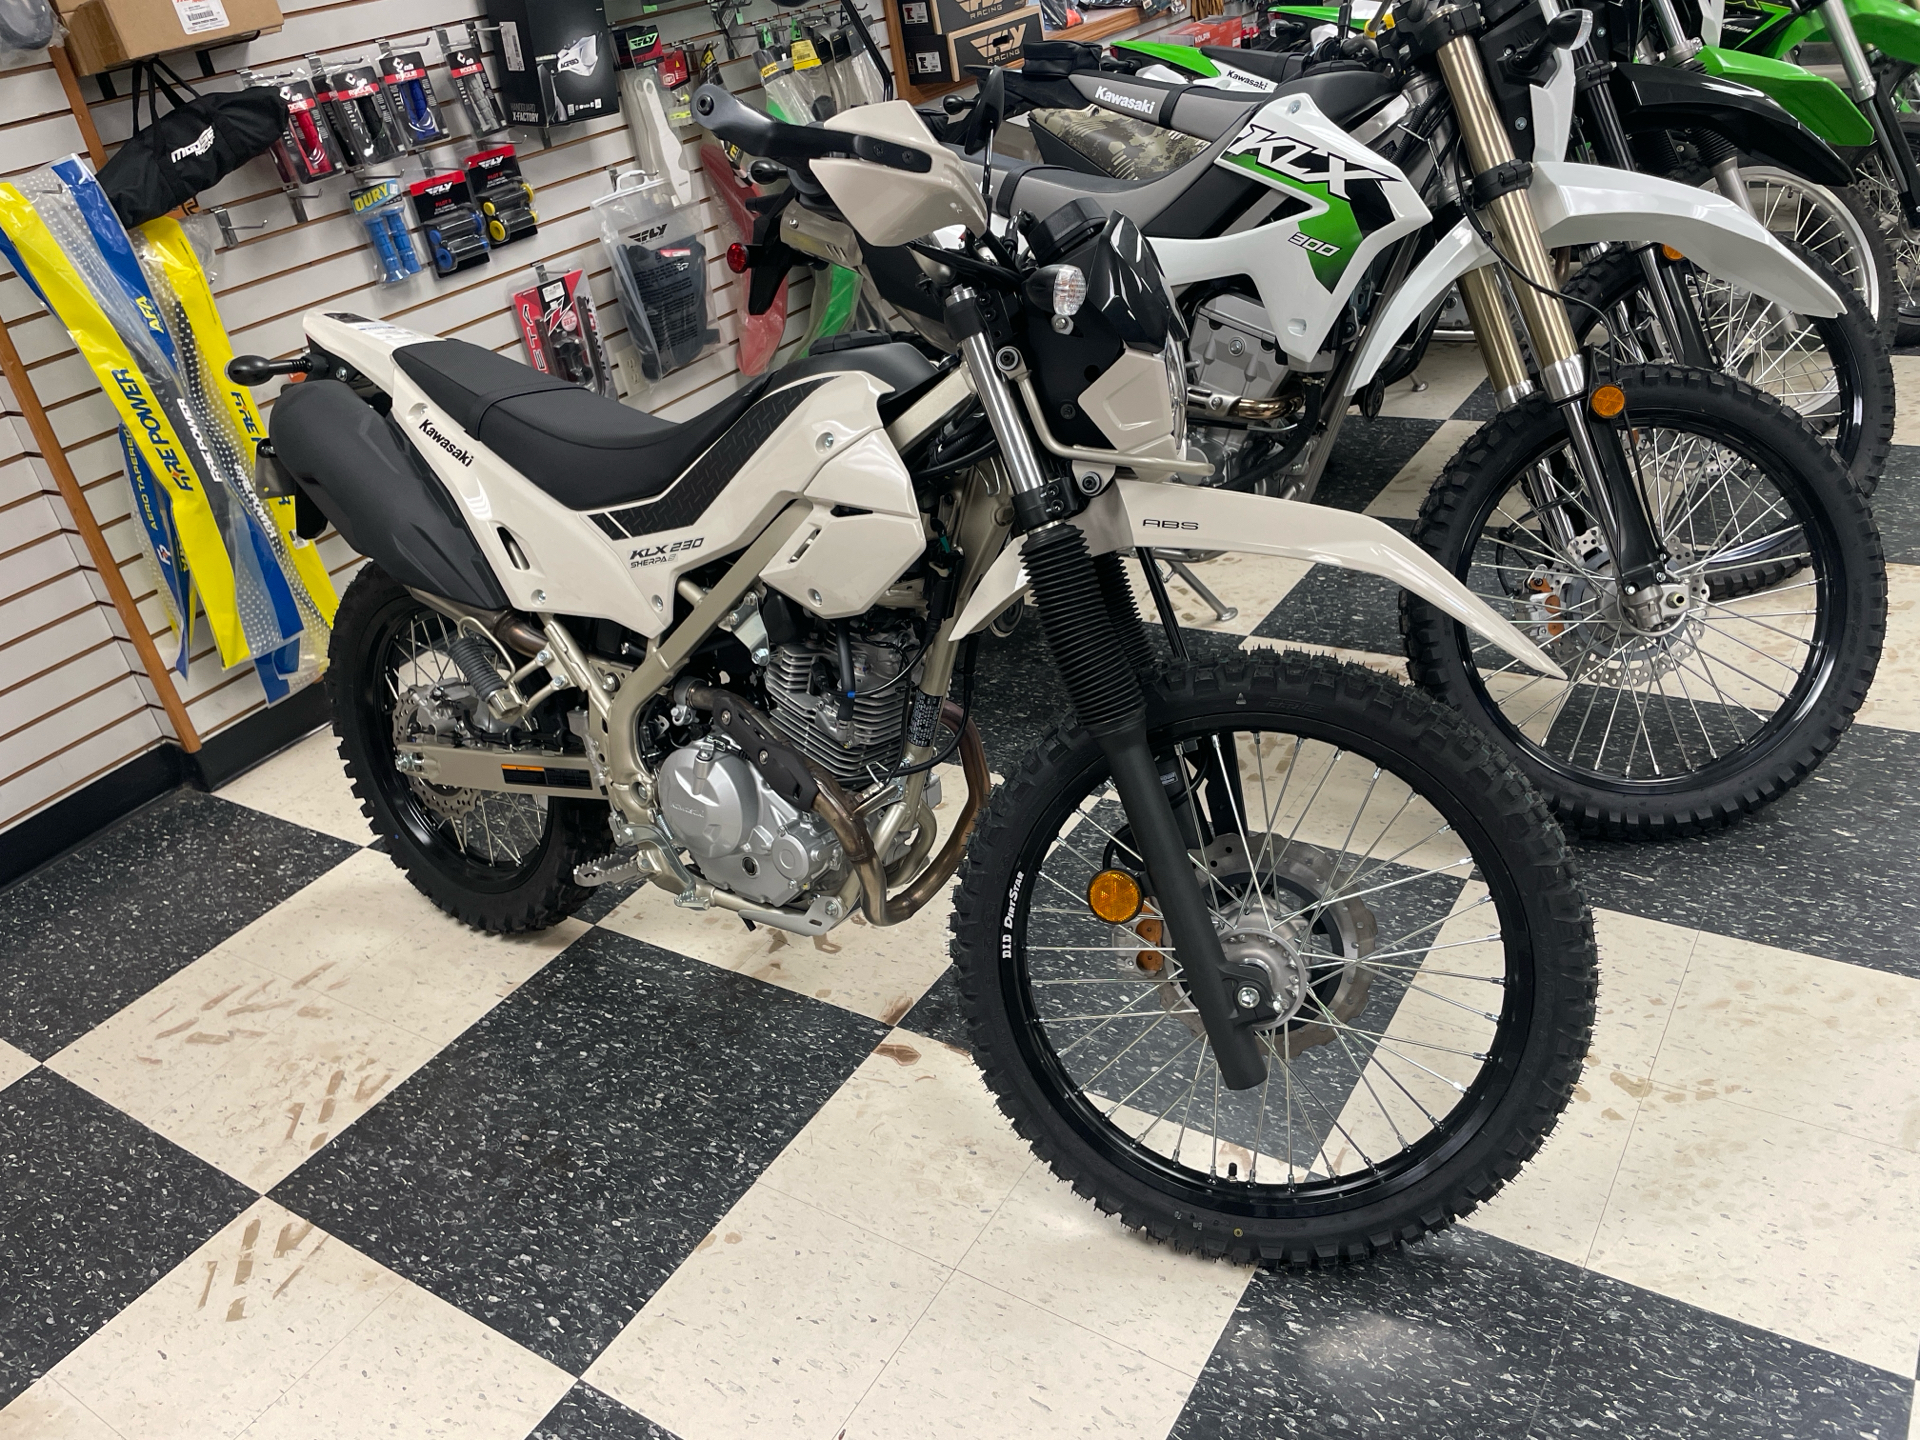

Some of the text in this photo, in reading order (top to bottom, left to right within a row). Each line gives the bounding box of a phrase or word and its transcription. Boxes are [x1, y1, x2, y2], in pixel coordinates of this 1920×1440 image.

[969, 4, 1003, 19] RACING
[630, 35, 656, 47] FLY
[970, 23, 1017, 58] FLY
[987, 49, 1020, 64] RACING
[1227, 70, 1268, 90] Kawasaki
[1095, 86, 1156, 114] Kawasaki
[478, 155, 504, 168] FLY
[1227, 124, 1402, 201] KLX
[354, 183, 388, 211] OURY
[425, 182, 453, 195] FLY
[628, 223, 668, 243] FLY
[1288, 231, 1342, 257] 300
[177, 398, 209, 451] POWER
[231, 391, 260, 434] FIRE
[111, 367, 194, 492] FIRE POWER
[418, 418, 475, 468] Kawasaki
[123, 428, 158, 530] AERO TAPERED
[1142, 518, 1199, 530] ABS
[629, 537, 705, 560] KLX 230
[630, 555, 667, 569] SHERPA
[1002, 934, 1012, 959] DID
